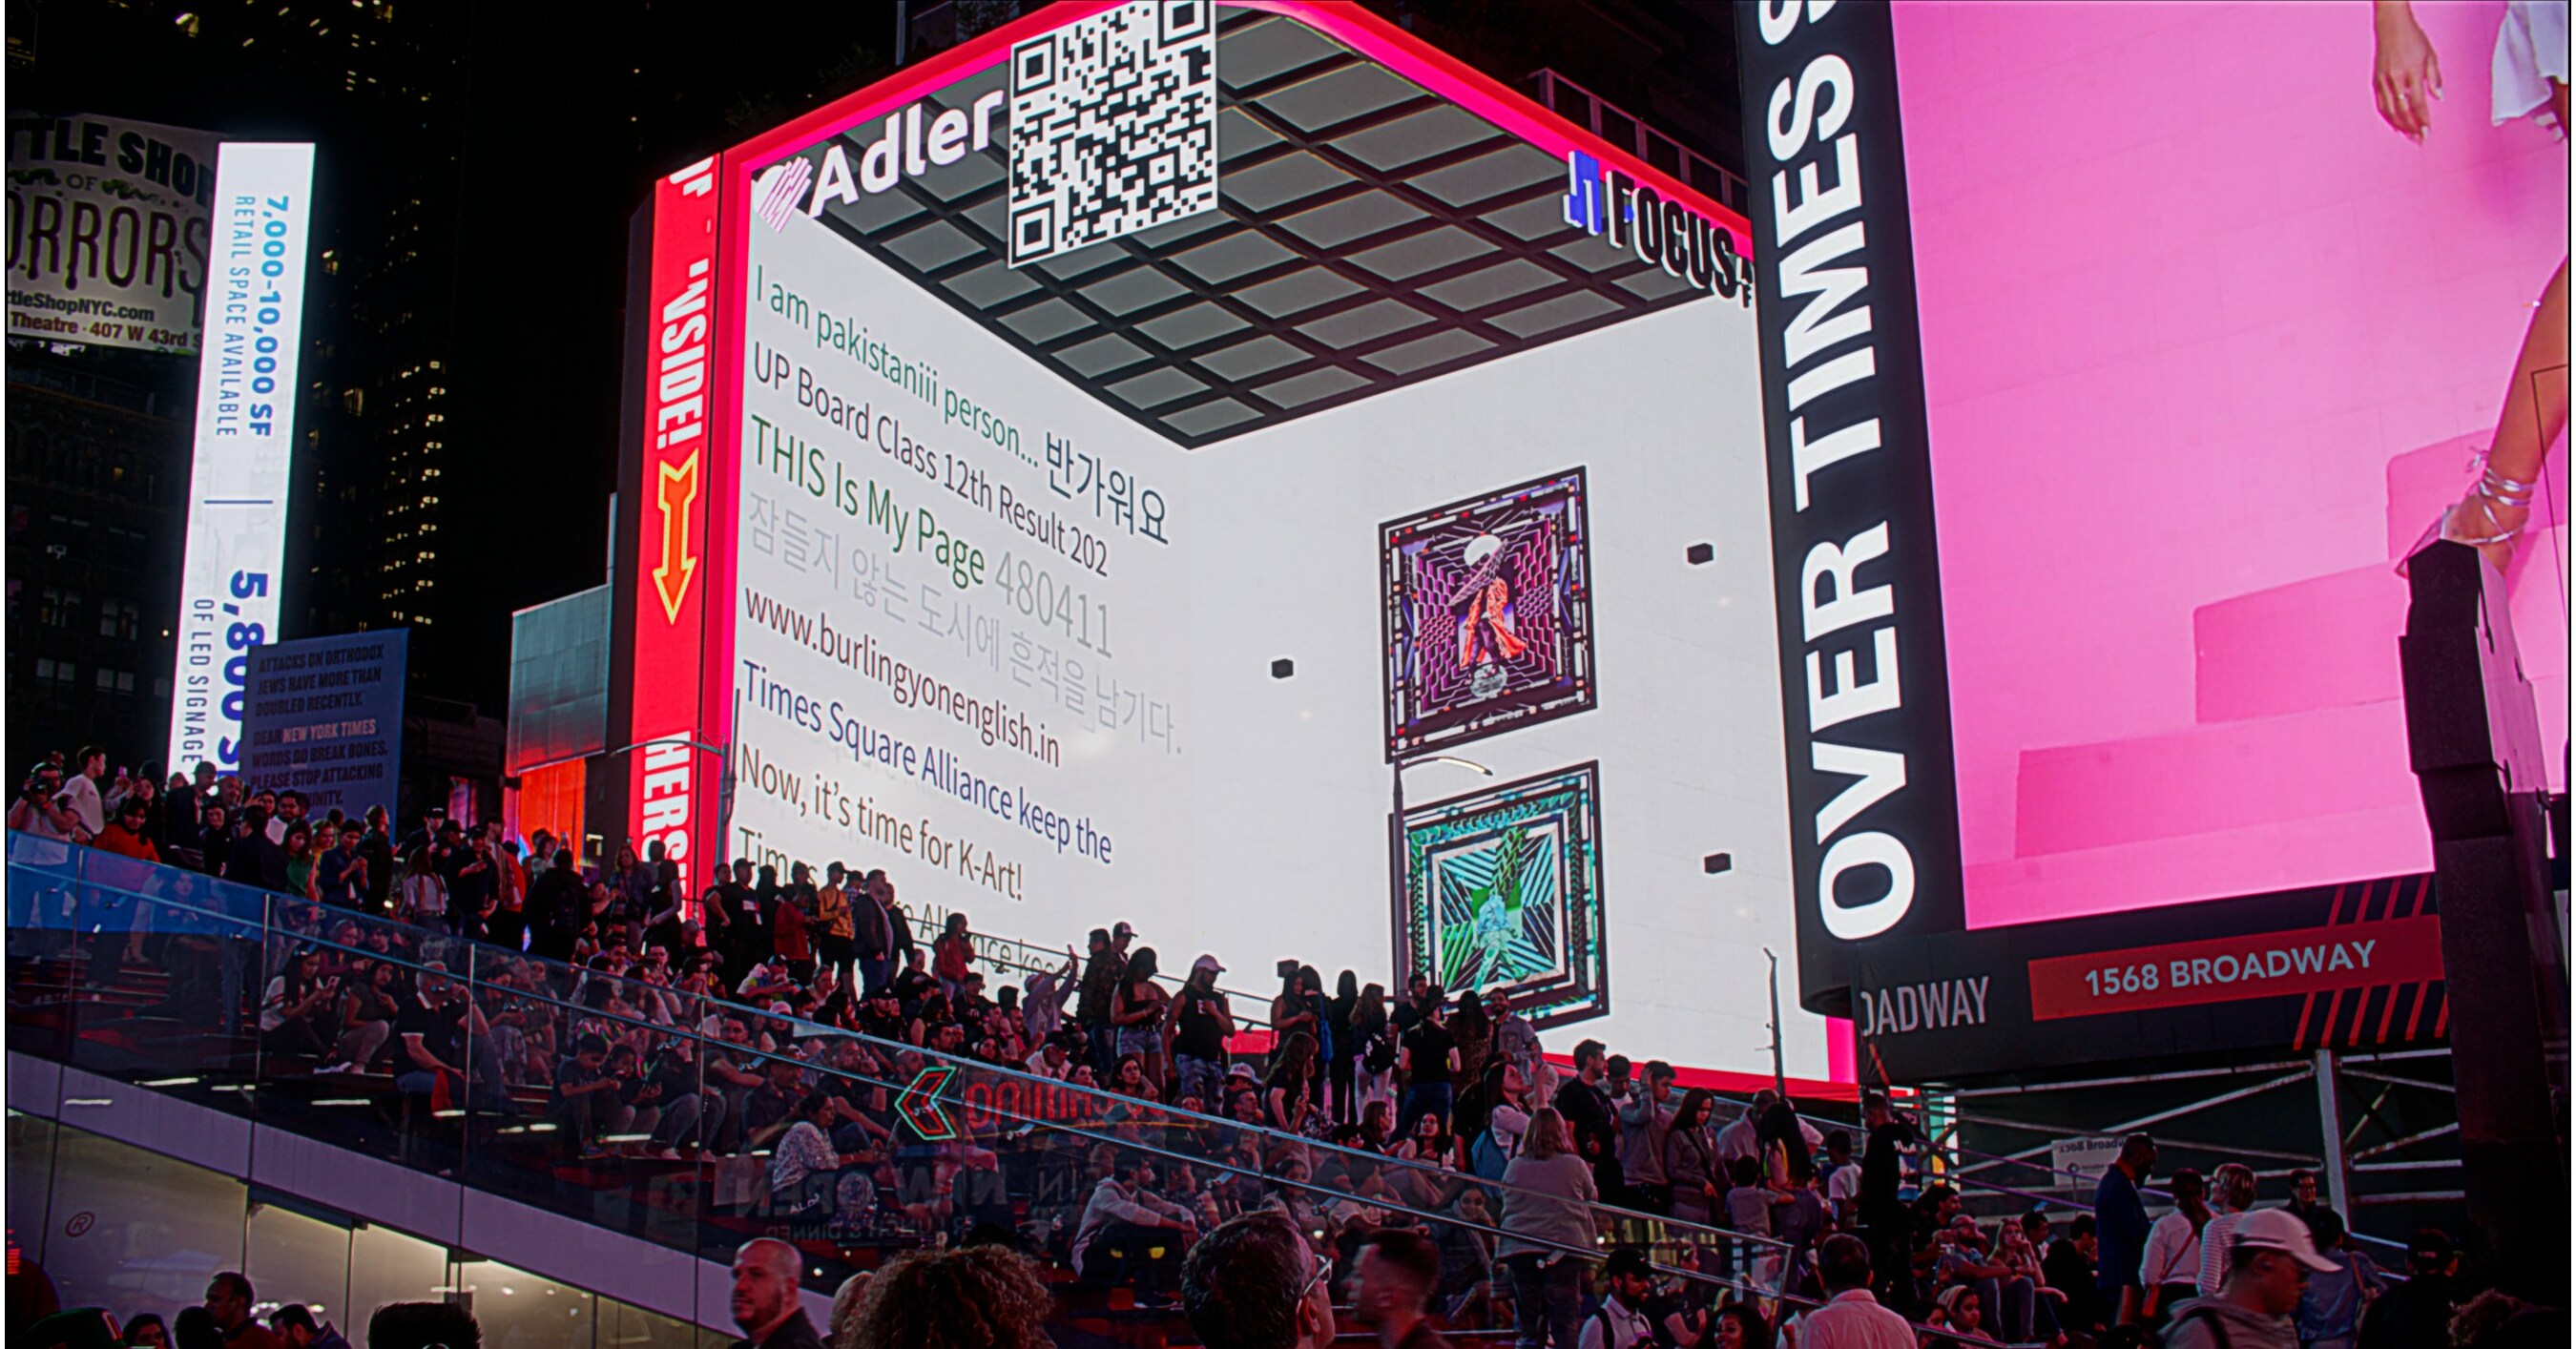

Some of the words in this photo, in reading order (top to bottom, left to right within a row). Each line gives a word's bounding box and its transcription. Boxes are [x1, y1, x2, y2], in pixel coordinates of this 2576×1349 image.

[66, 173, 98, 191] OF
[808, 90, 1004, 218] Adler
[231, 196, 256, 259] RETAIL
[1607, 170, 1739, 299] FOCUS
[225, 266, 250, 324] SPACE
[252, 195, 289, 394] 7,000-10,000
[1767, 54, 1881, 512] TIMES
[10, 311, 78, 334] Theatre
[90, 322, 123, 339] 407
[127, 324, 144, 342] W
[148, 328, 188, 346] 43rd
[216, 333, 245, 437] AVAILABLE
[757, 264, 762, 301] I
[770, 282, 809, 329] am
[817, 310, 938, 407] pakistaniii
[944, 385, 1039, 469] person...
[249, 403, 274, 437] SF
[753, 341, 790, 391] UP
[798, 365, 870, 442] Board
[877, 414, 937, 480] Class
[944, 454, 992, 513] 12th
[999, 485, 1066, 555] Result
[1070, 527, 1108, 578] 202
[1047, 431, 1169, 546] 반가워요
[751, 413, 825, 498] THIS
[836, 462, 859, 516] Is
[867, 480, 909, 553] My
[918, 508, 985, 590] Page
[995, 551, 1112, 659] 480411
[193, 598, 216, 622] OF
[749, 491, 840, 591] 잠들지
[852, 548, 909, 624] 않는
[918, 583, 1000, 673] 도시에
[1009, 631, 1087, 716] 흔적을
[1096, 674, 1182, 755] 남기다.
[190, 632, 213, 666] LED
[257, 677, 285, 695] JEWS
[288, 674, 316, 692] HAVE
[319, 670, 350, 688] MORE
[352, 666, 382, 684] THAN
[259, 654, 306, 673] ATTACKS
[308, 652, 323, 668] ON
[325, 644, 384, 666] ORTHODOX
[745, 586, 1060, 769] www.burlingyonenglish.in
[182, 675, 209, 763] SIGNAGE
[254, 729, 281, 746] DEAR
[281, 726, 308, 743] NEW
[309, 723, 339, 740] YORK
[256, 697, 304, 716] DOUBLED
[307, 691, 364, 711] RECENTLY.
[1800, 520, 1916, 941] OVER
[251, 772, 291, 789] PLEASE
[293, 769, 321, 786] STOP
[322, 763, 384, 782] ATTACKING
[252, 751, 291, 768] WORDS
[293, 748, 307, 764] DO
[310, 744, 345, 762] BREAK
[348, 740, 387, 758] BONES.
[742, 659, 821, 733] Times
[829, 701, 917, 777] Square
[921, 746, 1012, 820] Alliance
[1018, 786, 1070, 855] keep
[1076, 818, 1112, 865] the
[308, 790, 343, 807] UNITY.
[741, 742, 807, 818] Now,
[858, 797, 913, 855] time
[920, 819, 953, 869] for
[959, 839, 1022, 902] K-Art!
[738, 826, 818, 885] Tims
[2085, 964, 2160, 997] 1568
[2171, 940, 2376, 987] BROADWAY
